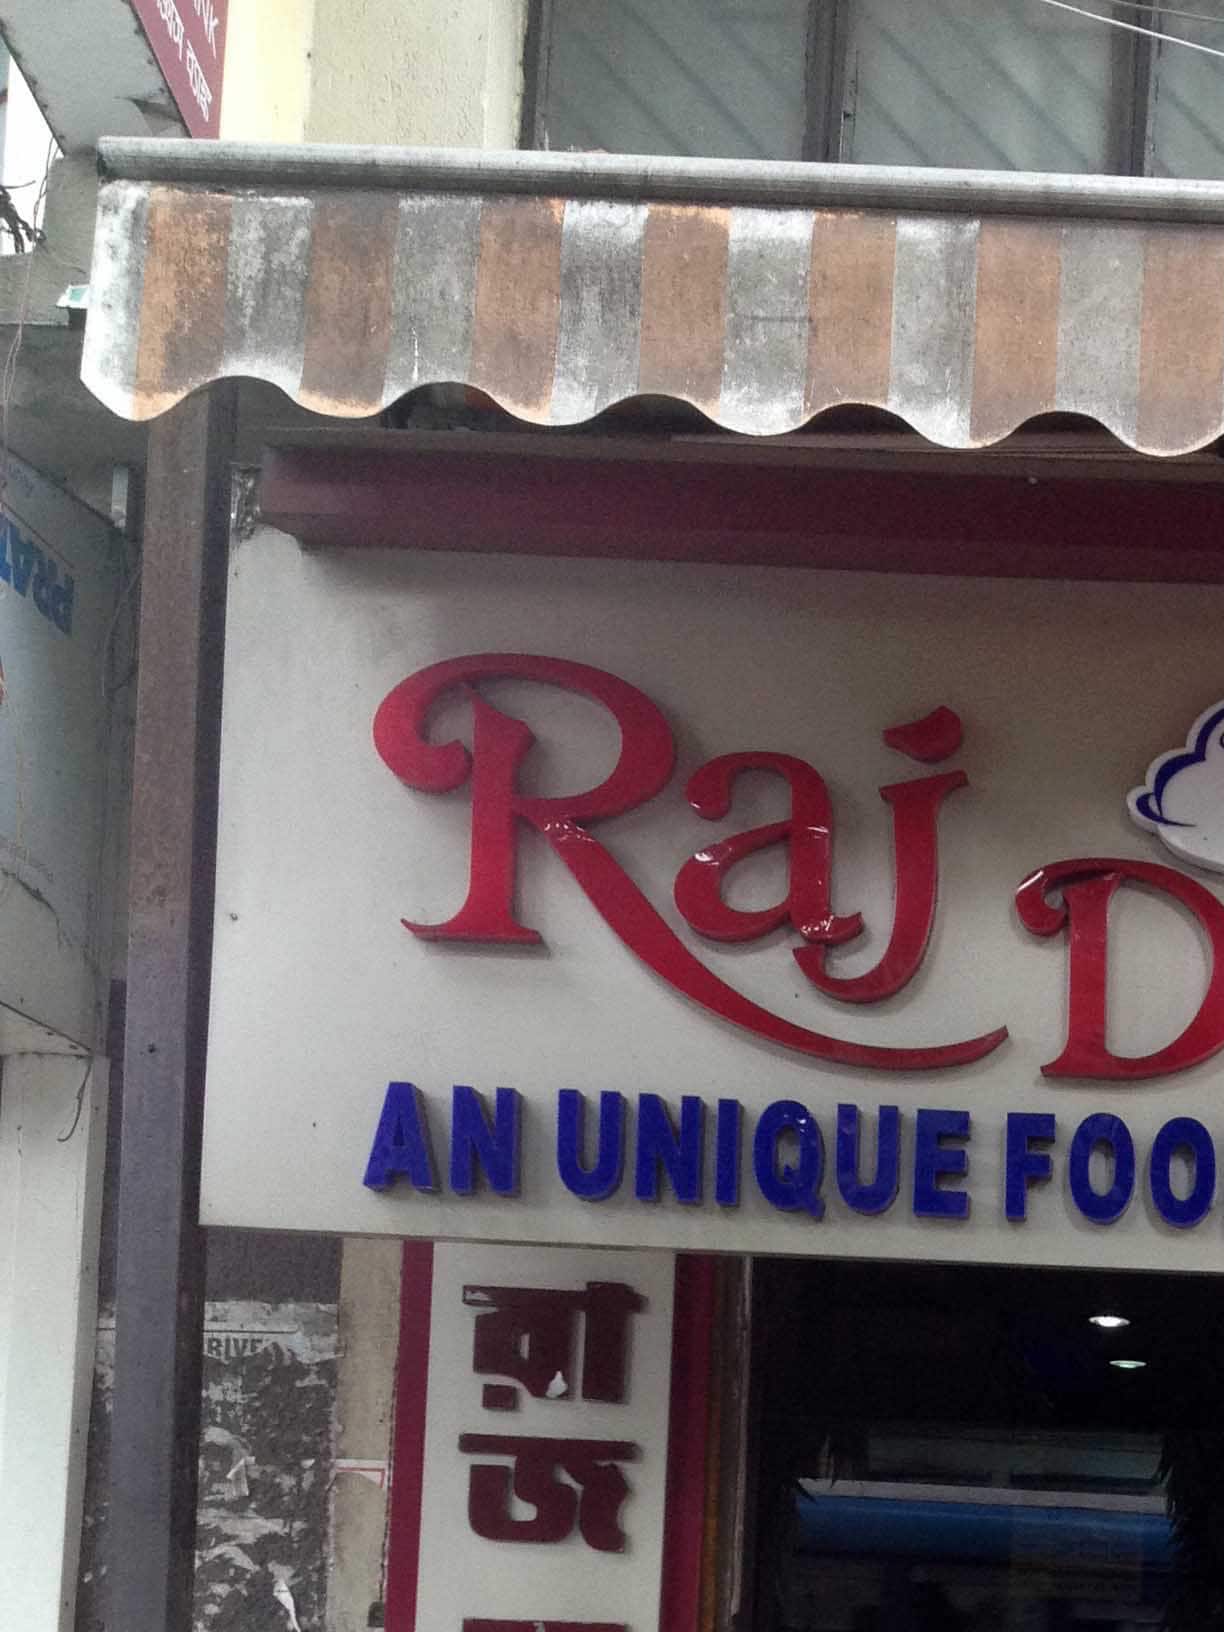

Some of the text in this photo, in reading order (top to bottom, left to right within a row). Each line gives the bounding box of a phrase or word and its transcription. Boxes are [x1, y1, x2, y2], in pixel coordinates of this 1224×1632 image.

[373, 652, 1009, 1072] Raj
[363, 1081, 522, 1198] AN
[557, 1088, 975, 1223] UNIQUE
